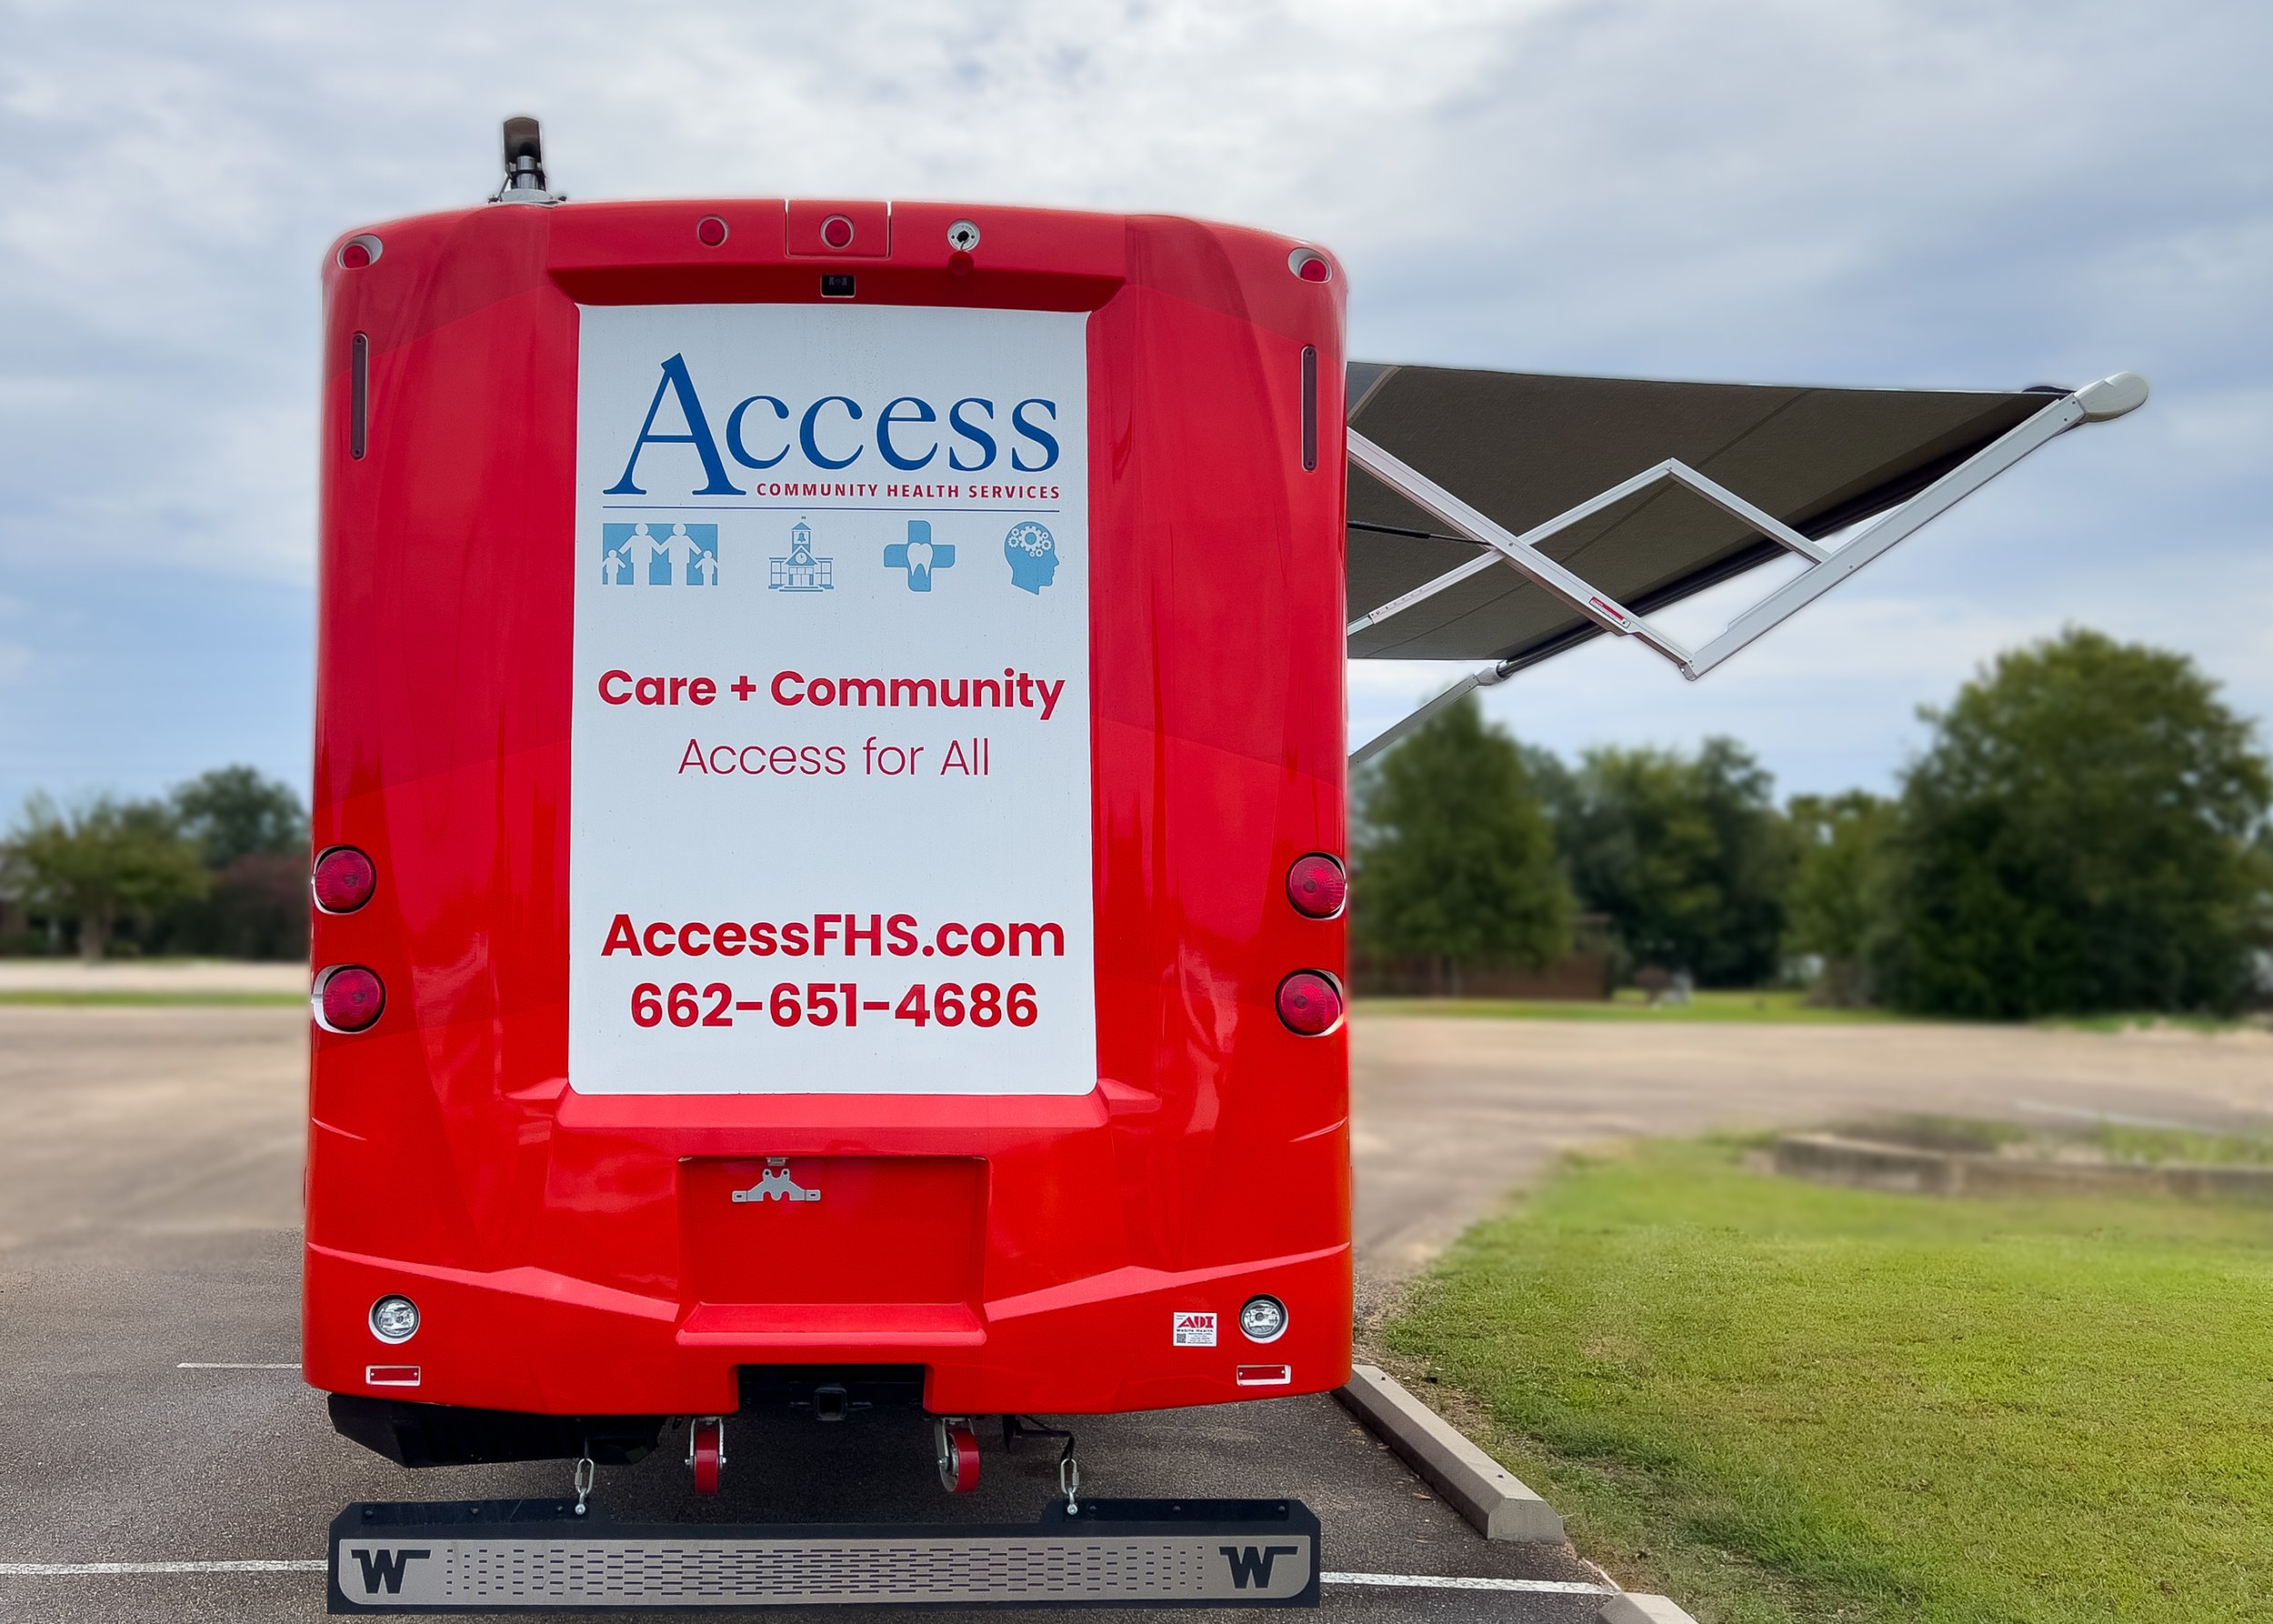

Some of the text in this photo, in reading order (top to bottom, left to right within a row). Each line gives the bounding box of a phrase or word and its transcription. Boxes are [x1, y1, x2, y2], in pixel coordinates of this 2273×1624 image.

[603, 352, 1060, 496] Access
[756, 482, 1060, 499] COMMUNITY HEALTH SERVICES
[597, 668, 1066, 720] Care + Community
[679, 737, 989, 776] Access for All
[601, 913, 1065, 957] AccessFHS.com
[631, 982, 1038, 1028] 662-651-4686
[1177, 1316, 1214, 1328] ADI
